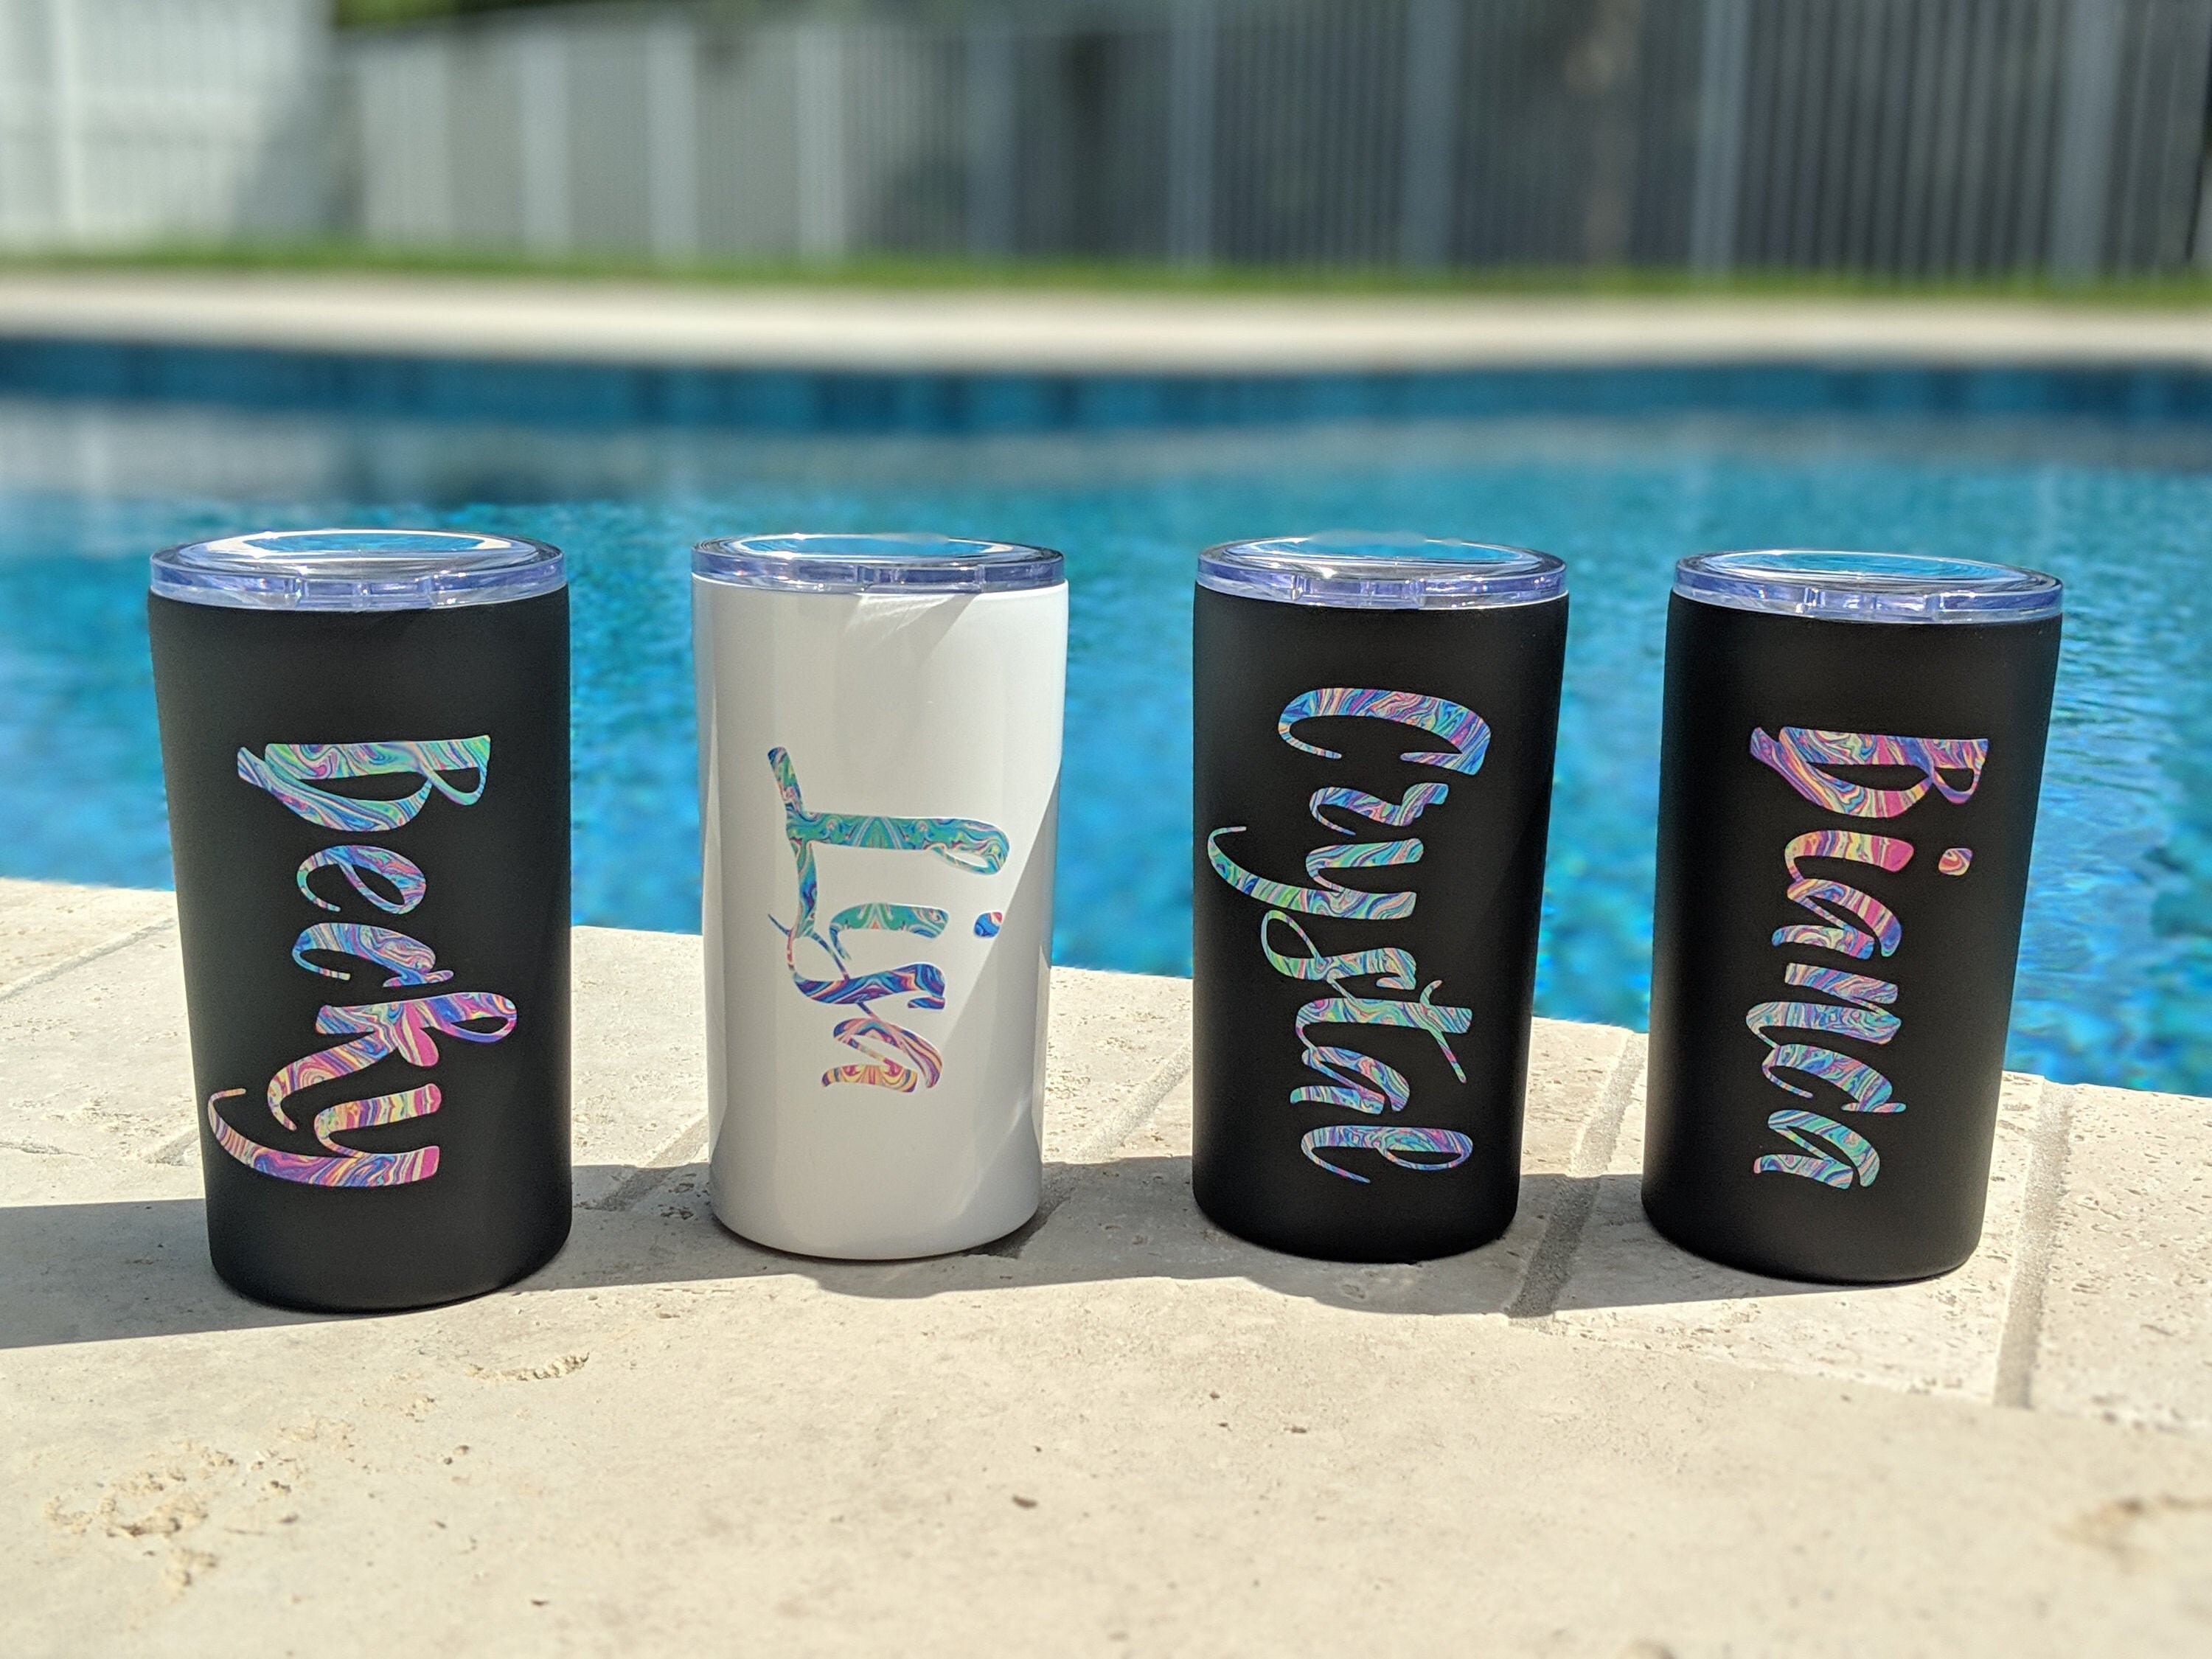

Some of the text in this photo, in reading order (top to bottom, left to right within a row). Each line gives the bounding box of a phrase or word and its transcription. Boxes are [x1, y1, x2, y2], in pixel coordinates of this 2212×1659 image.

[207, 734, 518, 1188] Becky
[767, 746, 1011, 1094] Lisa
[1207, 687, 1492, 1184] Crystal
[1746, 726, 1989, 1190] Bianca
